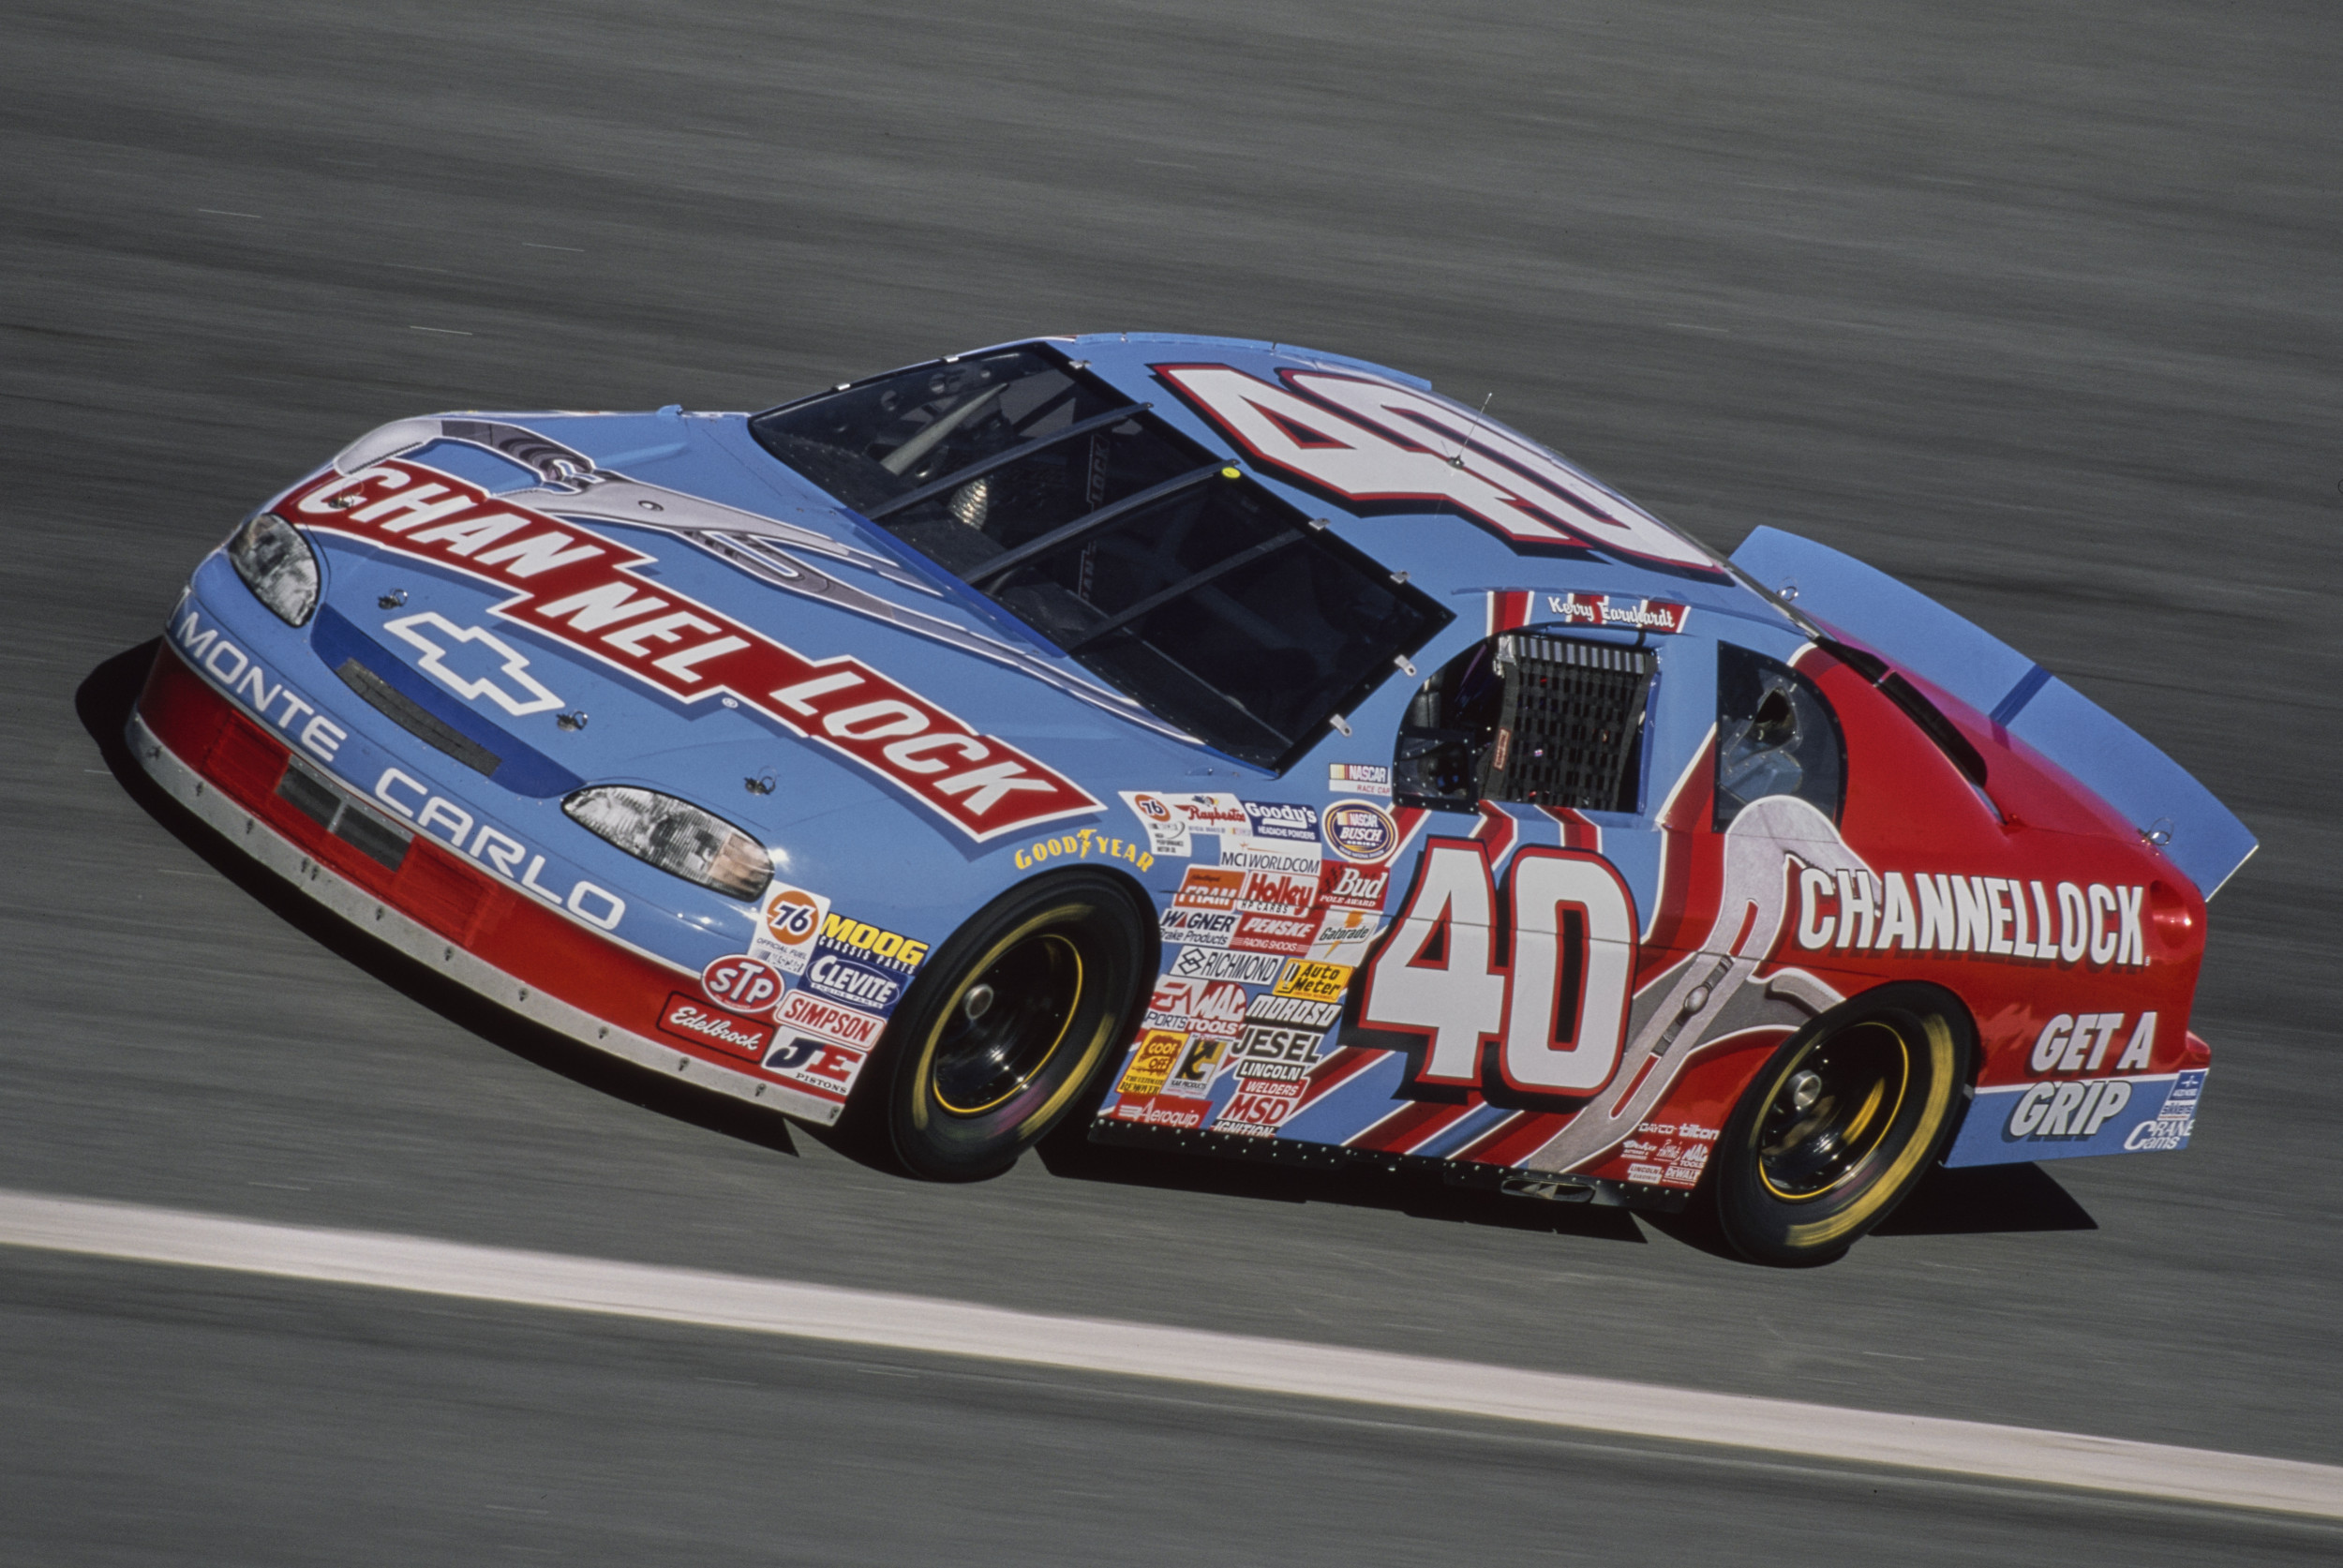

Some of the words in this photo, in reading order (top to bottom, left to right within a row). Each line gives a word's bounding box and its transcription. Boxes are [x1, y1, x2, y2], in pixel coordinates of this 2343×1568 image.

[1153, 363, 1724, 574] 40
[1548, 597, 1593, 621] Kerry
[1597, 601, 1676, 627] Earnhardt
[175, 612, 348, 762] MONTE
[375, 767, 626, 931] CARLO
[1350, 765, 1387, 784] NASCAR
[1357, 784, 1376, 794] RACE
[1142, 799, 1164, 815] 76
[1244, 802, 1317, 829] Goody's
[1349, 812, 1379, 828] NASCAR
[1340, 827, 1383, 842] BUSCH
[1179, 886, 1237, 905] FRAM
[1246, 872, 1314, 916] Holley
[1332, 867, 1388, 899] Bud
[1260, 903, 1289, 914] CARBS
[1320, 895, 1345, 903] POLE
[1345, 898, 1376, 907] AWARD
[769, 903, 813, 935] 76
[1160, 910, 1235, 933] WAGNER
[1243, 918, 1314, 937] PENSKE
[1798, 868, 2144, 966] CHANNELLOCK
[819, 913, 929, 966] MOOG
[1184, 931, 1228, 945] Products
[1243, 938, 1271, 948] RACING
[1269, 941, 1298, 952] SHOCKS
[1319, 926, 1369, 941] Gatorade
[756, 938, 787, 953] OFFICIAL
[789, 948, 807, 960] FUEL
[818, 935, 871, 961] CHASSIS
[876, 955, 916, 975] PARTS
[811, 955, 897, 1003] CLEVITE
[1201, 951, 1279, 981] RICHMOND
[1301, 963, 1340, 980] Auto
[1358, 838, 1639, 1097] 40
[709, 962, 774, 1004] STP
[1293, 978, 1341, 995] Meter
[1191, 984, 1246, 1022] MAC
[1246, 994, 1342, 1027] MOROSO
[670, 1007, 763, 1051] Edelbrock
[784, 999, 876, 1043] SIMPSON
[1143, 1011, 1188, 1029] PORTS
[1188, 1019, 1240, 1035] TOOLS
[1231, 1028, 1323, 1064] JESEL
[2032, 1012, 2126, 1072] GET
[2116, 1011, 2157, 1069] A
[766, 1037, 863, 1083] JE
[1240, 1063, 1302, 1081] LINCOLN
[796, 1072, 848, 1094] PISTONS
[1246, 1082, 1299, 1097] WELDERS
[1140, 1098, 1199, 1127] Aeroquip
[1222, 1094, 1291, 1125] MSD
[2009, 1082, 2132, 1136] GRIP
[1213, 1120, 1274, 1137] IGNITION
[1681, 1142, 1709, 1162] MAC
